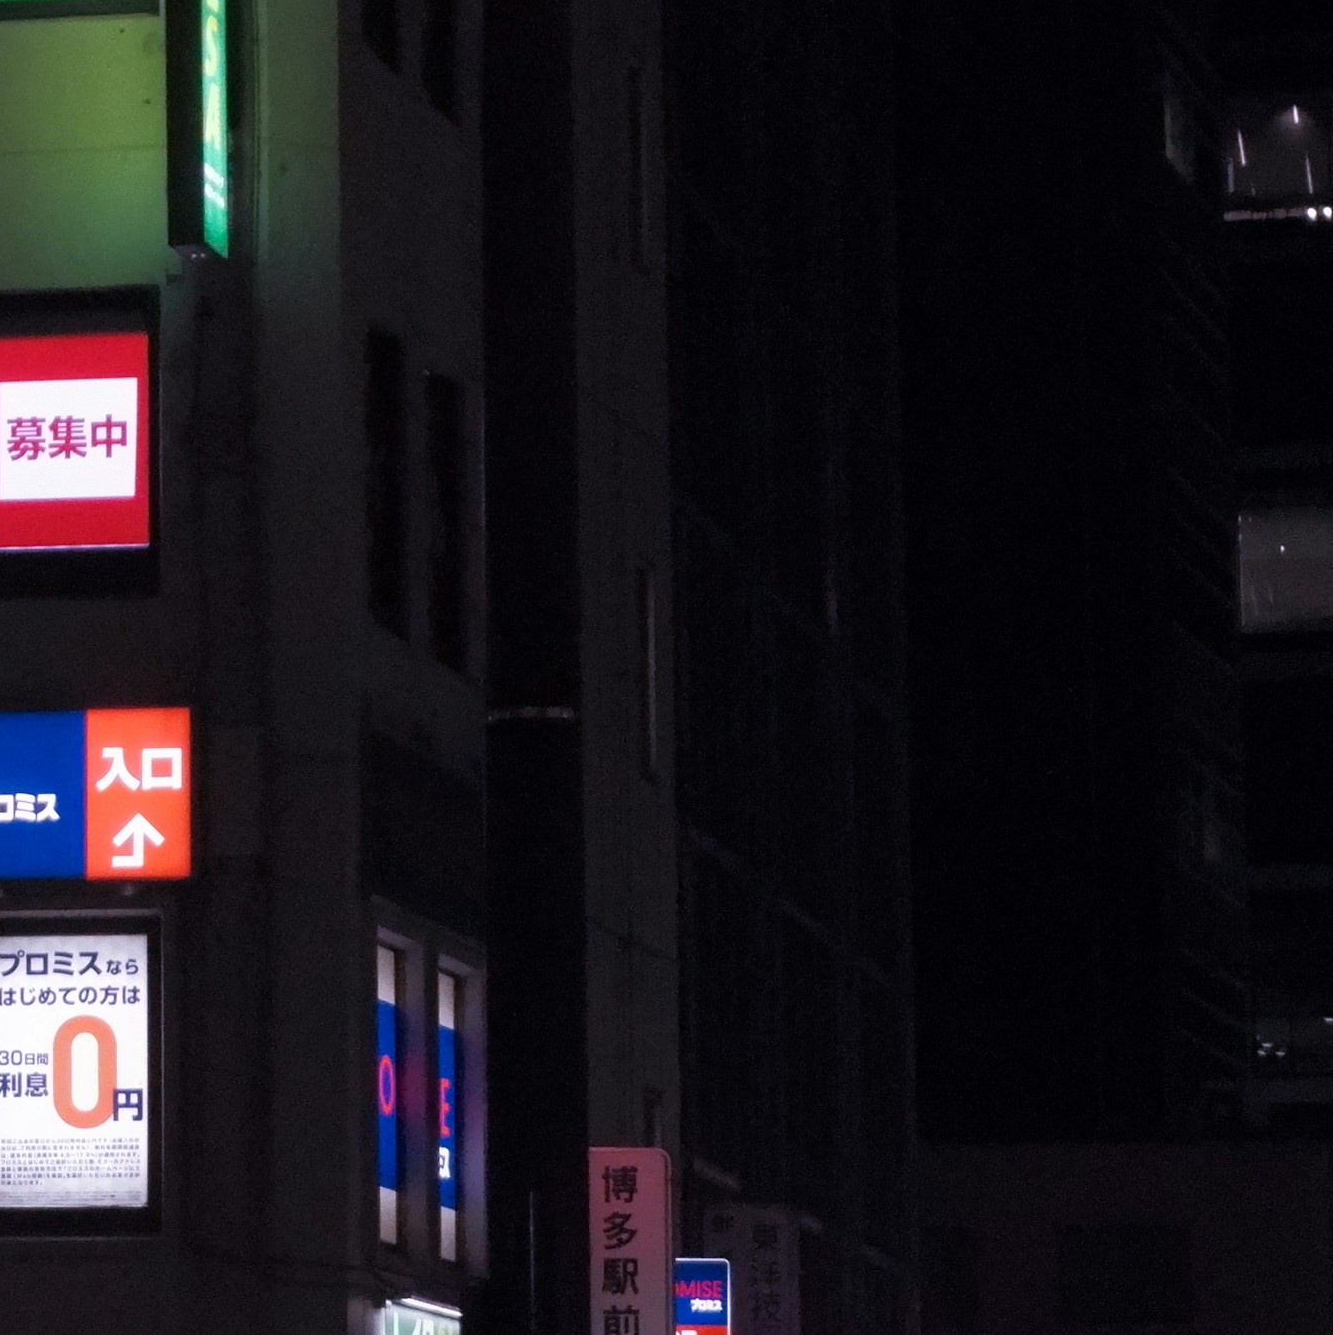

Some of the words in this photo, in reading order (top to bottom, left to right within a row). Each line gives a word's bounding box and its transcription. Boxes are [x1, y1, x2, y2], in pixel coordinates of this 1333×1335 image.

[96, 746, 183, 793] 入口
[602, 1166, 640, 1335] 博多駅前
